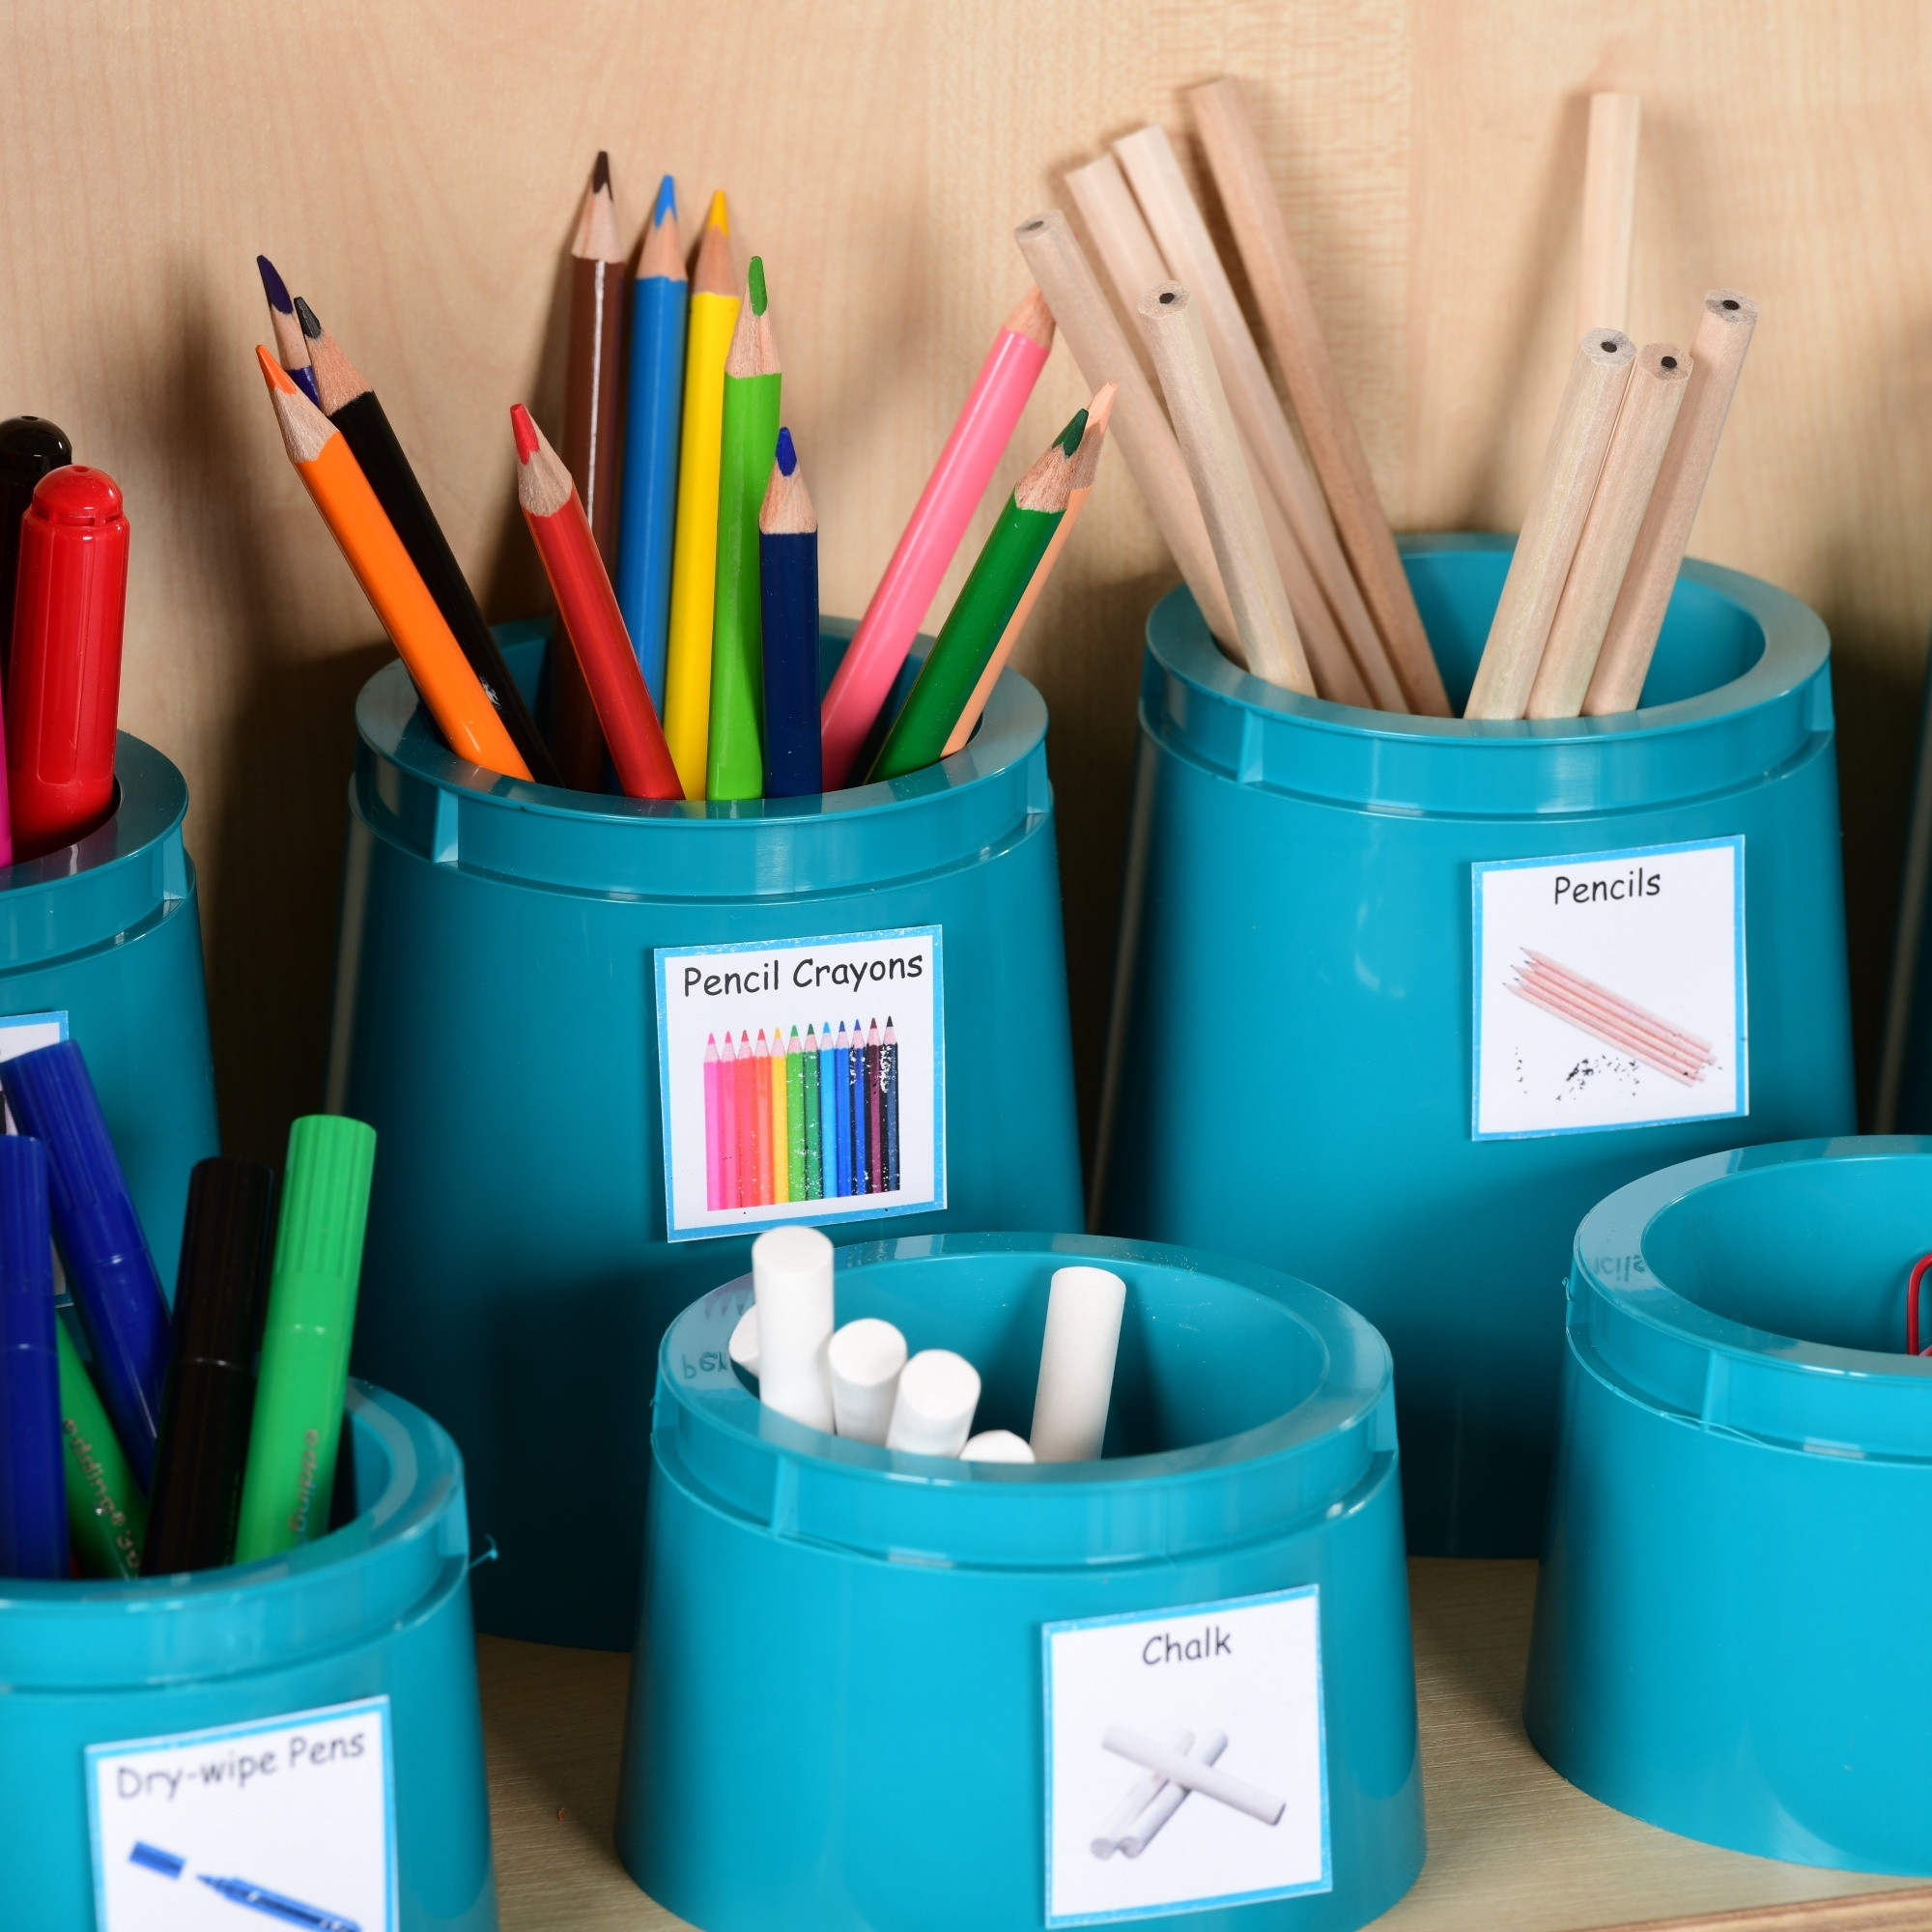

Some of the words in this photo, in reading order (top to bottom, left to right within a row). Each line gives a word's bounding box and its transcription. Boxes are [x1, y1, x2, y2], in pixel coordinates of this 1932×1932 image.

[1554, 867, 1661, 905] Pencils
[684, 959, 780, 997] Pencil
[792, 954, 923, 993] Crayons
[1142, 1625, 1232, 1666] Chalk
[116, 1749, 277, 1804] Dry-wipe
[289, 1731, 365, 1769] Pens
